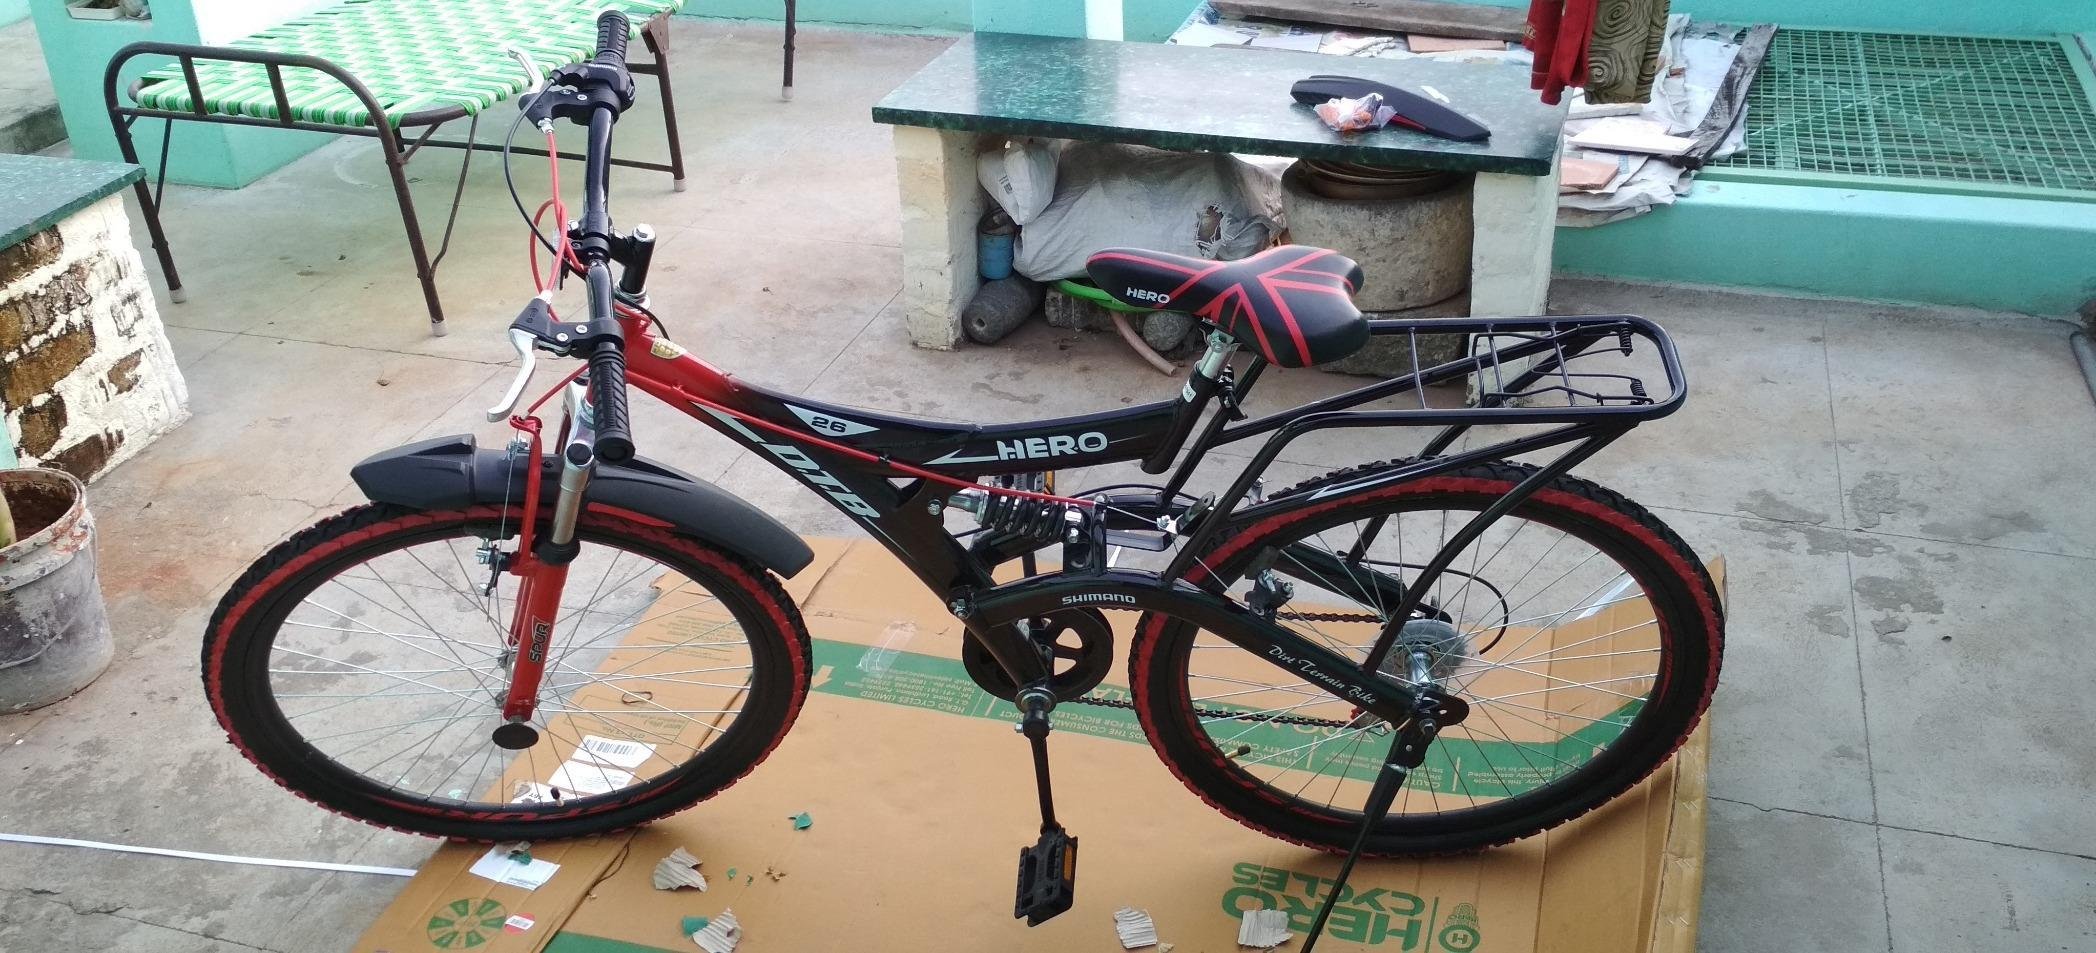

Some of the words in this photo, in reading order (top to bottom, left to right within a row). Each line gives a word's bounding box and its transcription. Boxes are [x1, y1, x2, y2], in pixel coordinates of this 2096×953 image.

[1126, 287, 1171, 305] HERO
[811, 416, 848, 433] 26
[997, 432, 1108, 461] HERO
[1062, 593, 1137, 605] SHIMANO
[529, 621, 553, 664] SPUR
[1268, 644, 1296, 664] Dirt
[1299, 658, 1346, 689] Terrain
[1348, 685, 1378, 705] Bike
[860, 691, 896, 702] LIMITED
[899, 697, 936, 708] CYCLES
[938, 703, 966, 714] HERO
[1105, 720, 1124, 729] FOR
[1108, 728, 1127, 738] THE
[1232, 863, 1426, 917] CYCLES
[1223, 887, 1422, 952] HERO
[1453, 933, 1468, 945] H
